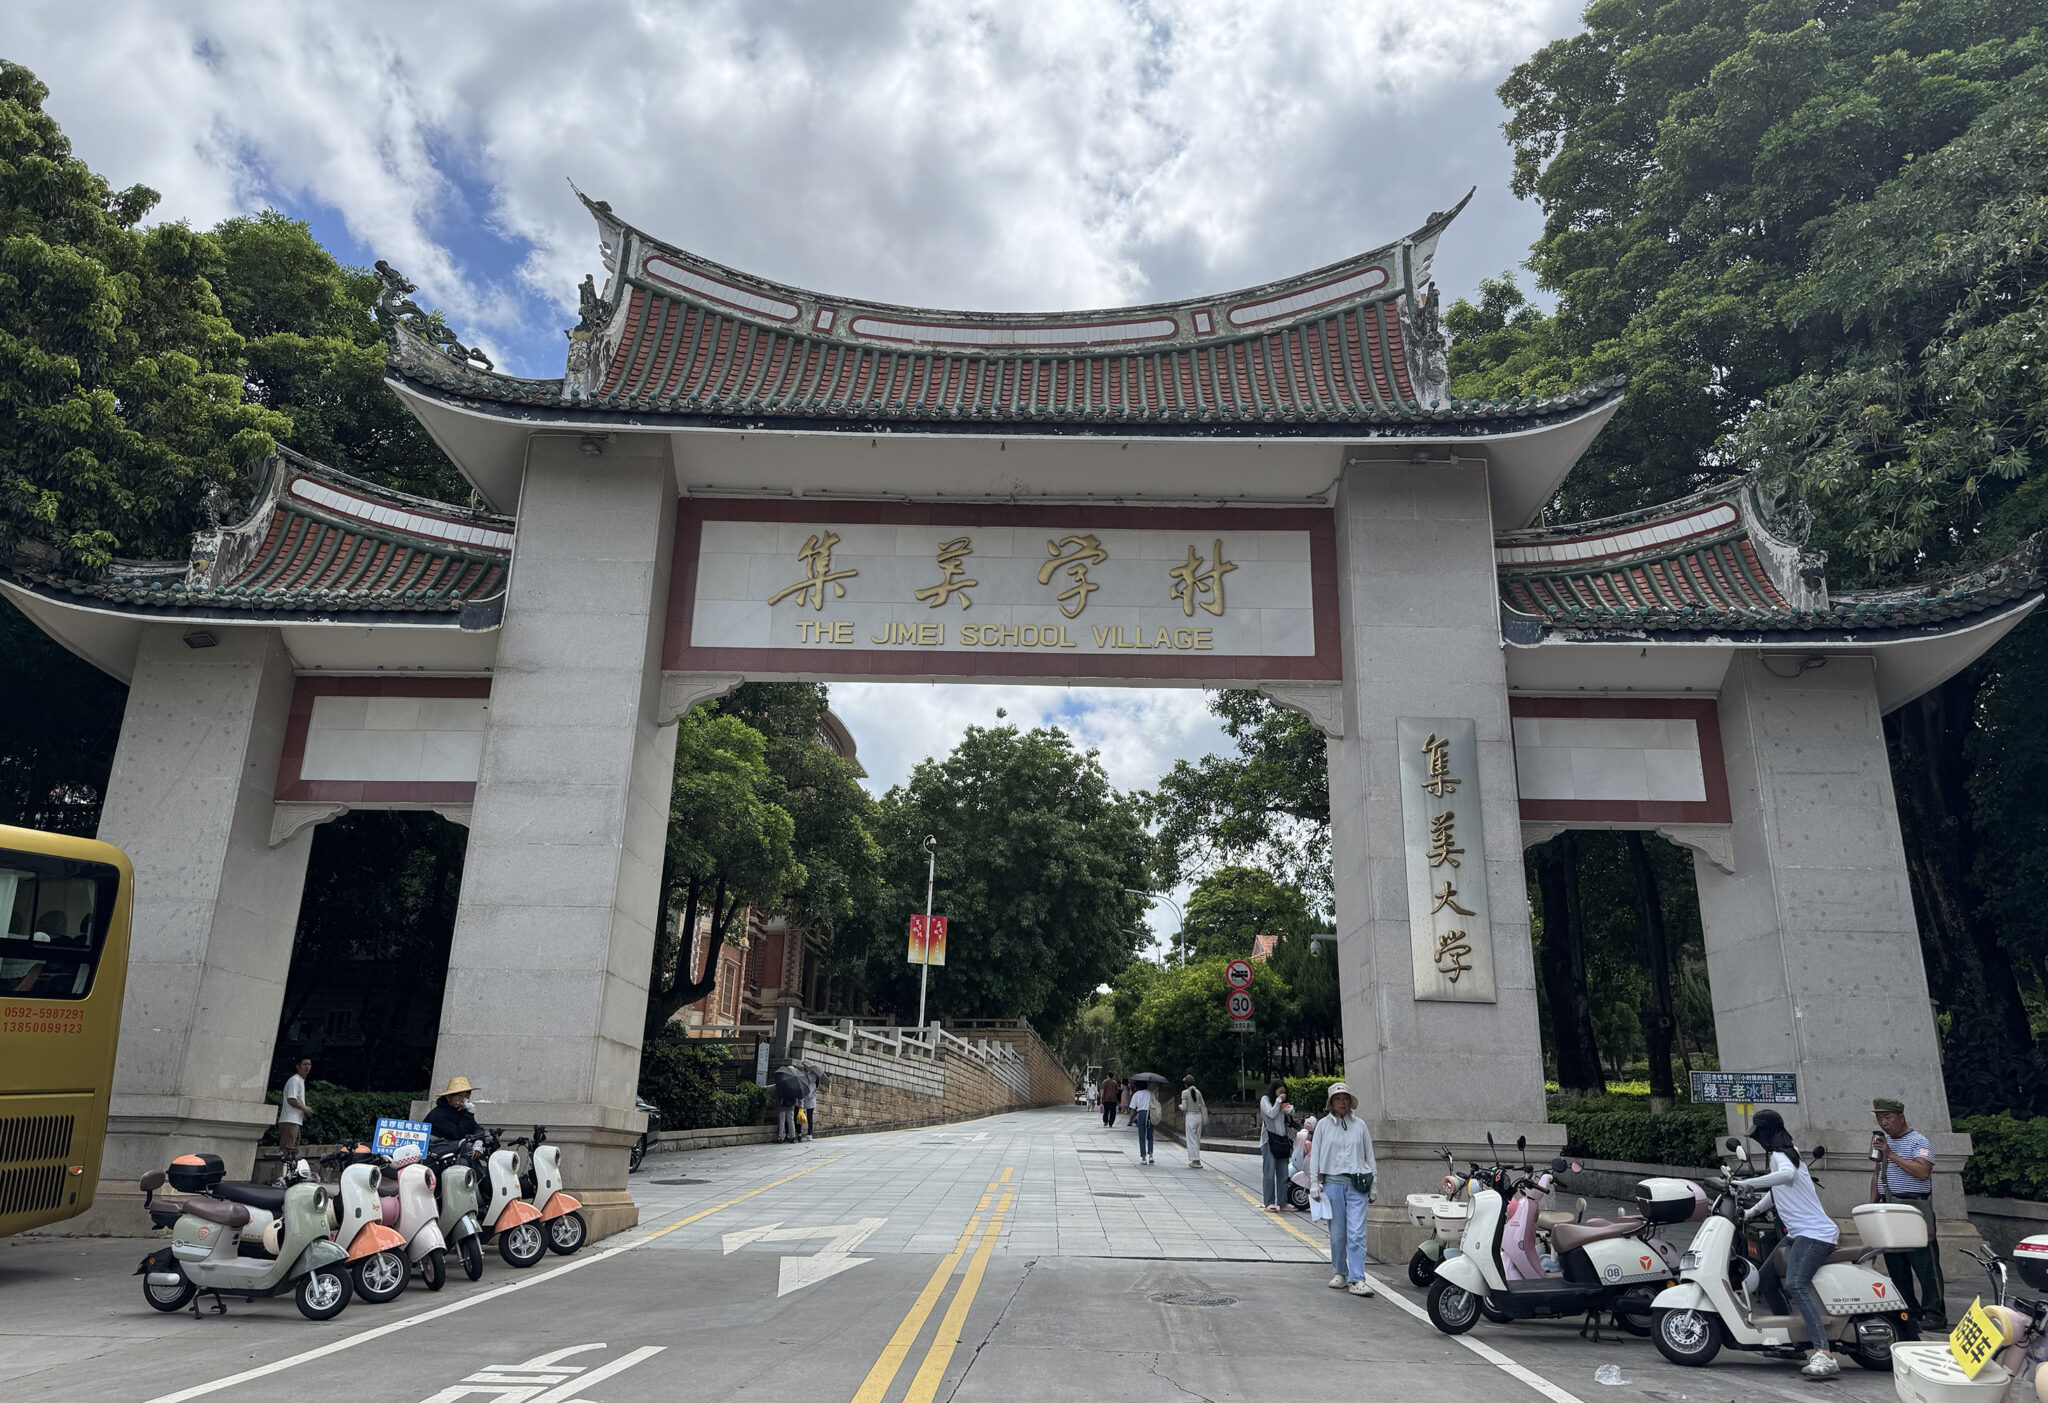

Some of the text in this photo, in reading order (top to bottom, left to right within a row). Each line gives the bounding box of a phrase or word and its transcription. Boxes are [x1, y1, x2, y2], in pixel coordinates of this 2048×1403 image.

[768, 530, 1239, 619] 集美学村
[795, 621, 1213, 650] THE JIMEI SCHOOL VILLAGE
[1421, 732, 1477, 984] 集美大学
[1232, 997, 1249, 1012] 30
[4, 1006, 85, 1020] 0592-5987291
[2, 1021, 83, 1034] 13850099123
[1703, 1083, 1775, 1099] 绿豆老冰棍
[1607, 1268, 1620, 1278] 08
